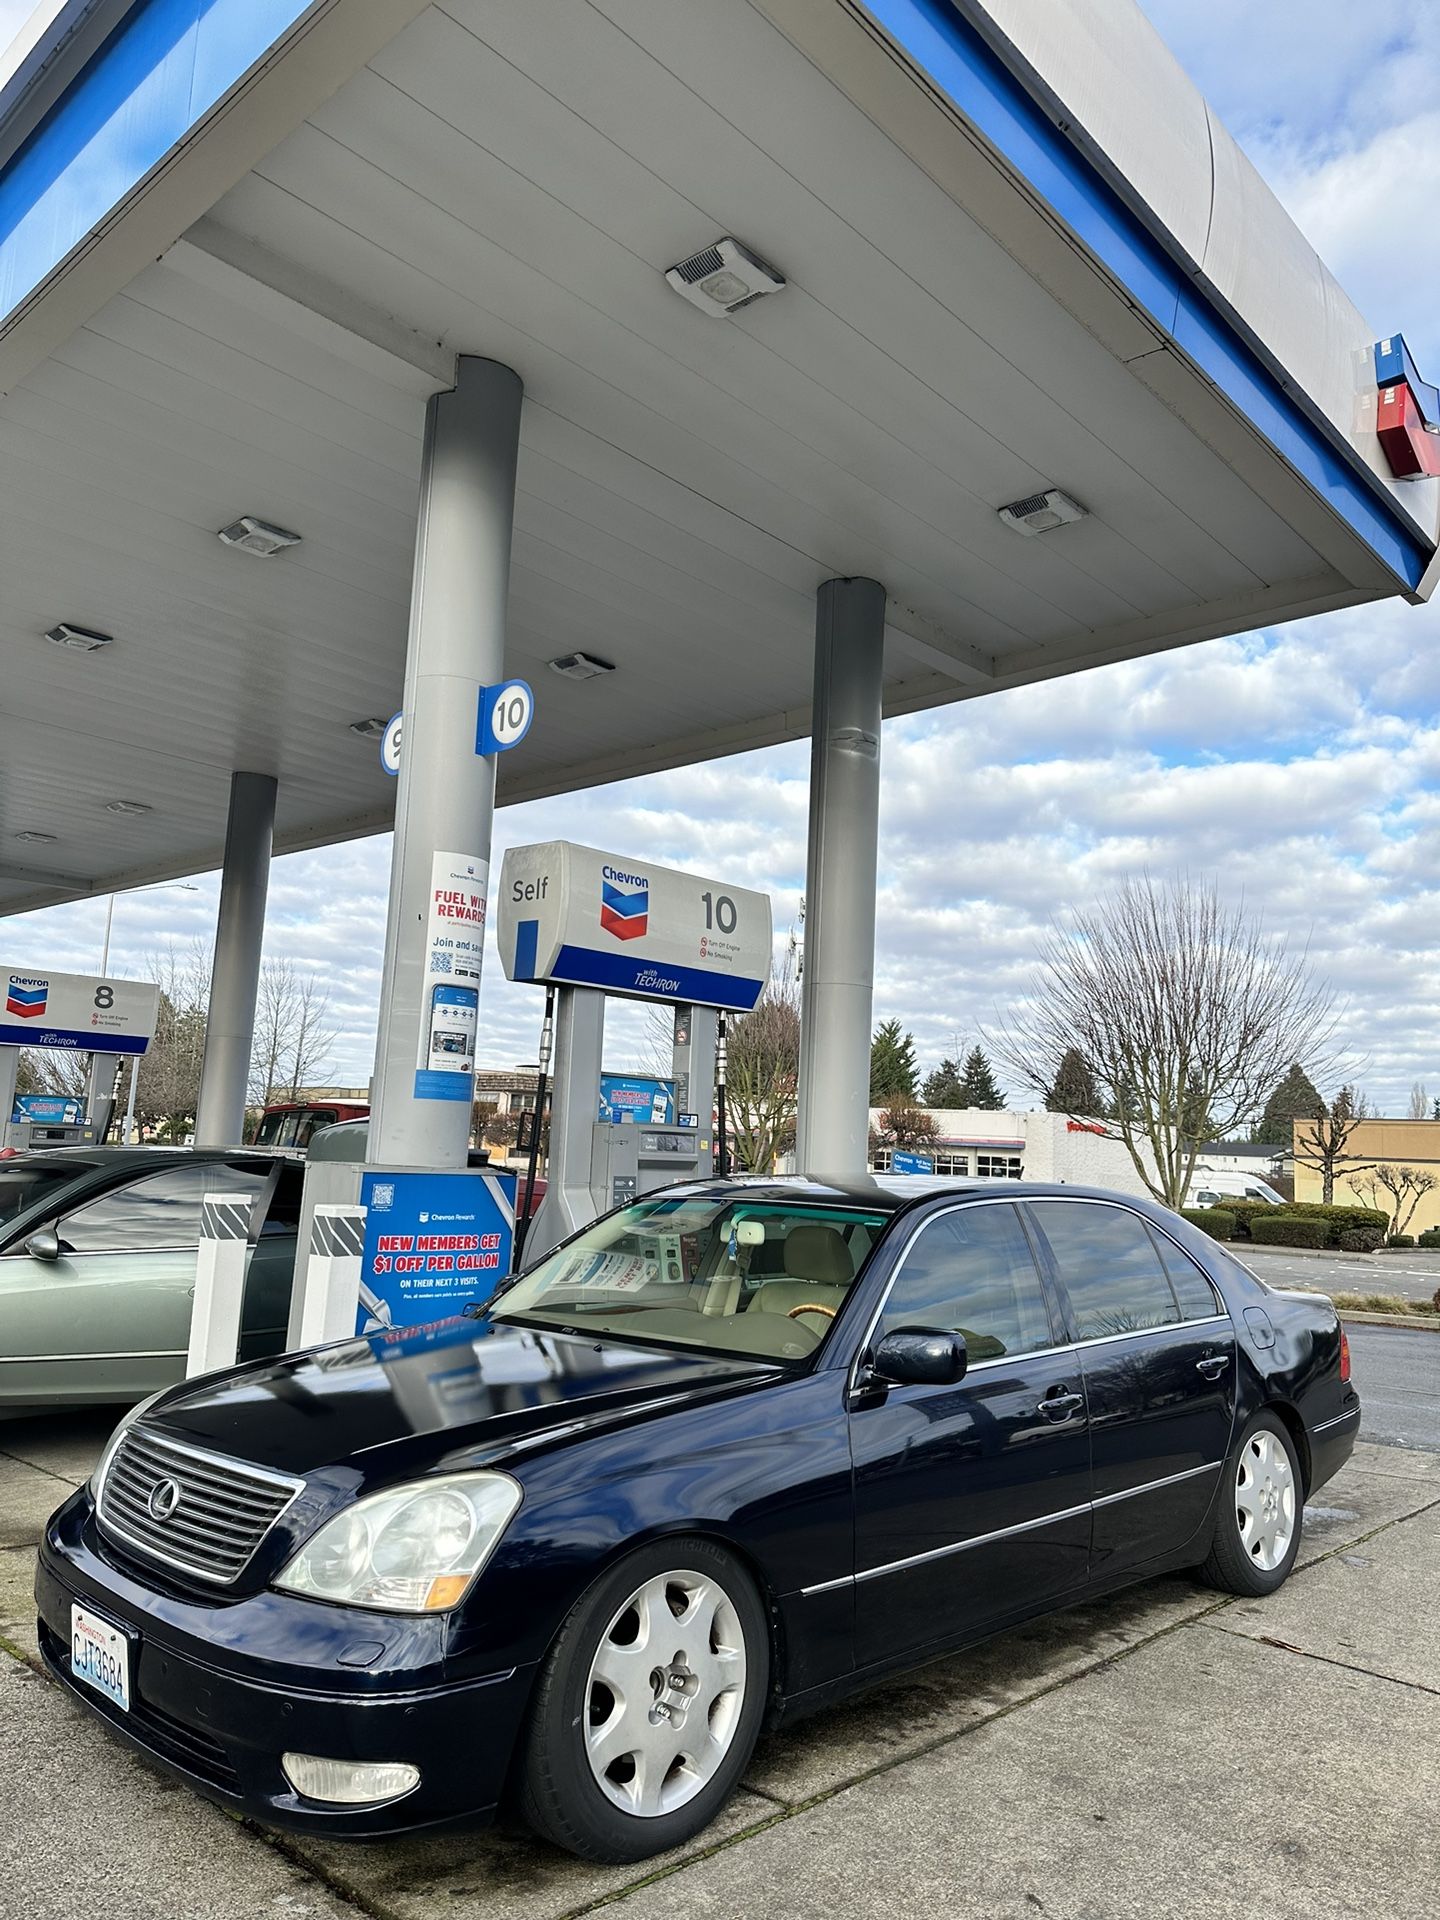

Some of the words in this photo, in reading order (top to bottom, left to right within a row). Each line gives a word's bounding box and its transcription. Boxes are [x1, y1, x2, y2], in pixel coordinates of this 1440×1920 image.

[497, 697, 524, 732] 10
[602, 865, 649, 888] Chevron
[434, 890, 467, 905] FUEL
[512, 876, 549, 902] Self
[437, 904, 486, 924] REWARDS
[702, 892, 738, 935] 10
[433, 936, 454, 948] Join
[455, 940, 471, 951] and
[714, 952, 732, 962] Smoking
[9, 975, 49, 987] Chevron
[634, 972, 681, 992] TECHRON
[643, 969, 658, 977] with
[94, 985, 114, 1009] 8
[39, 1035, 78, 1046] TECHRON
[431, 1213, 455, 1221] Chevron
[377, 1235, 415, 1252] NEW
[417, 1234, 478, 1251] MEMBERS
[481, 1233, 501, 1250] GET
[373, 1255, 392, 1275] $1
[394, 1255, 424, 1273] OFF
[426, 1255, 453, 1272] PER
[456, 1252, 500, 1271] GALLON
[400, 1279, 411, 1288] ON
[413, 1279, 434, 1288] THEIR
[435, 1278, 453, 1287] NEXT
[454, 1278, 459, 1286] 3
[460, 1276, 479, 1286] VISITS.
[73, 1632, 123, 1697] CJT3684
